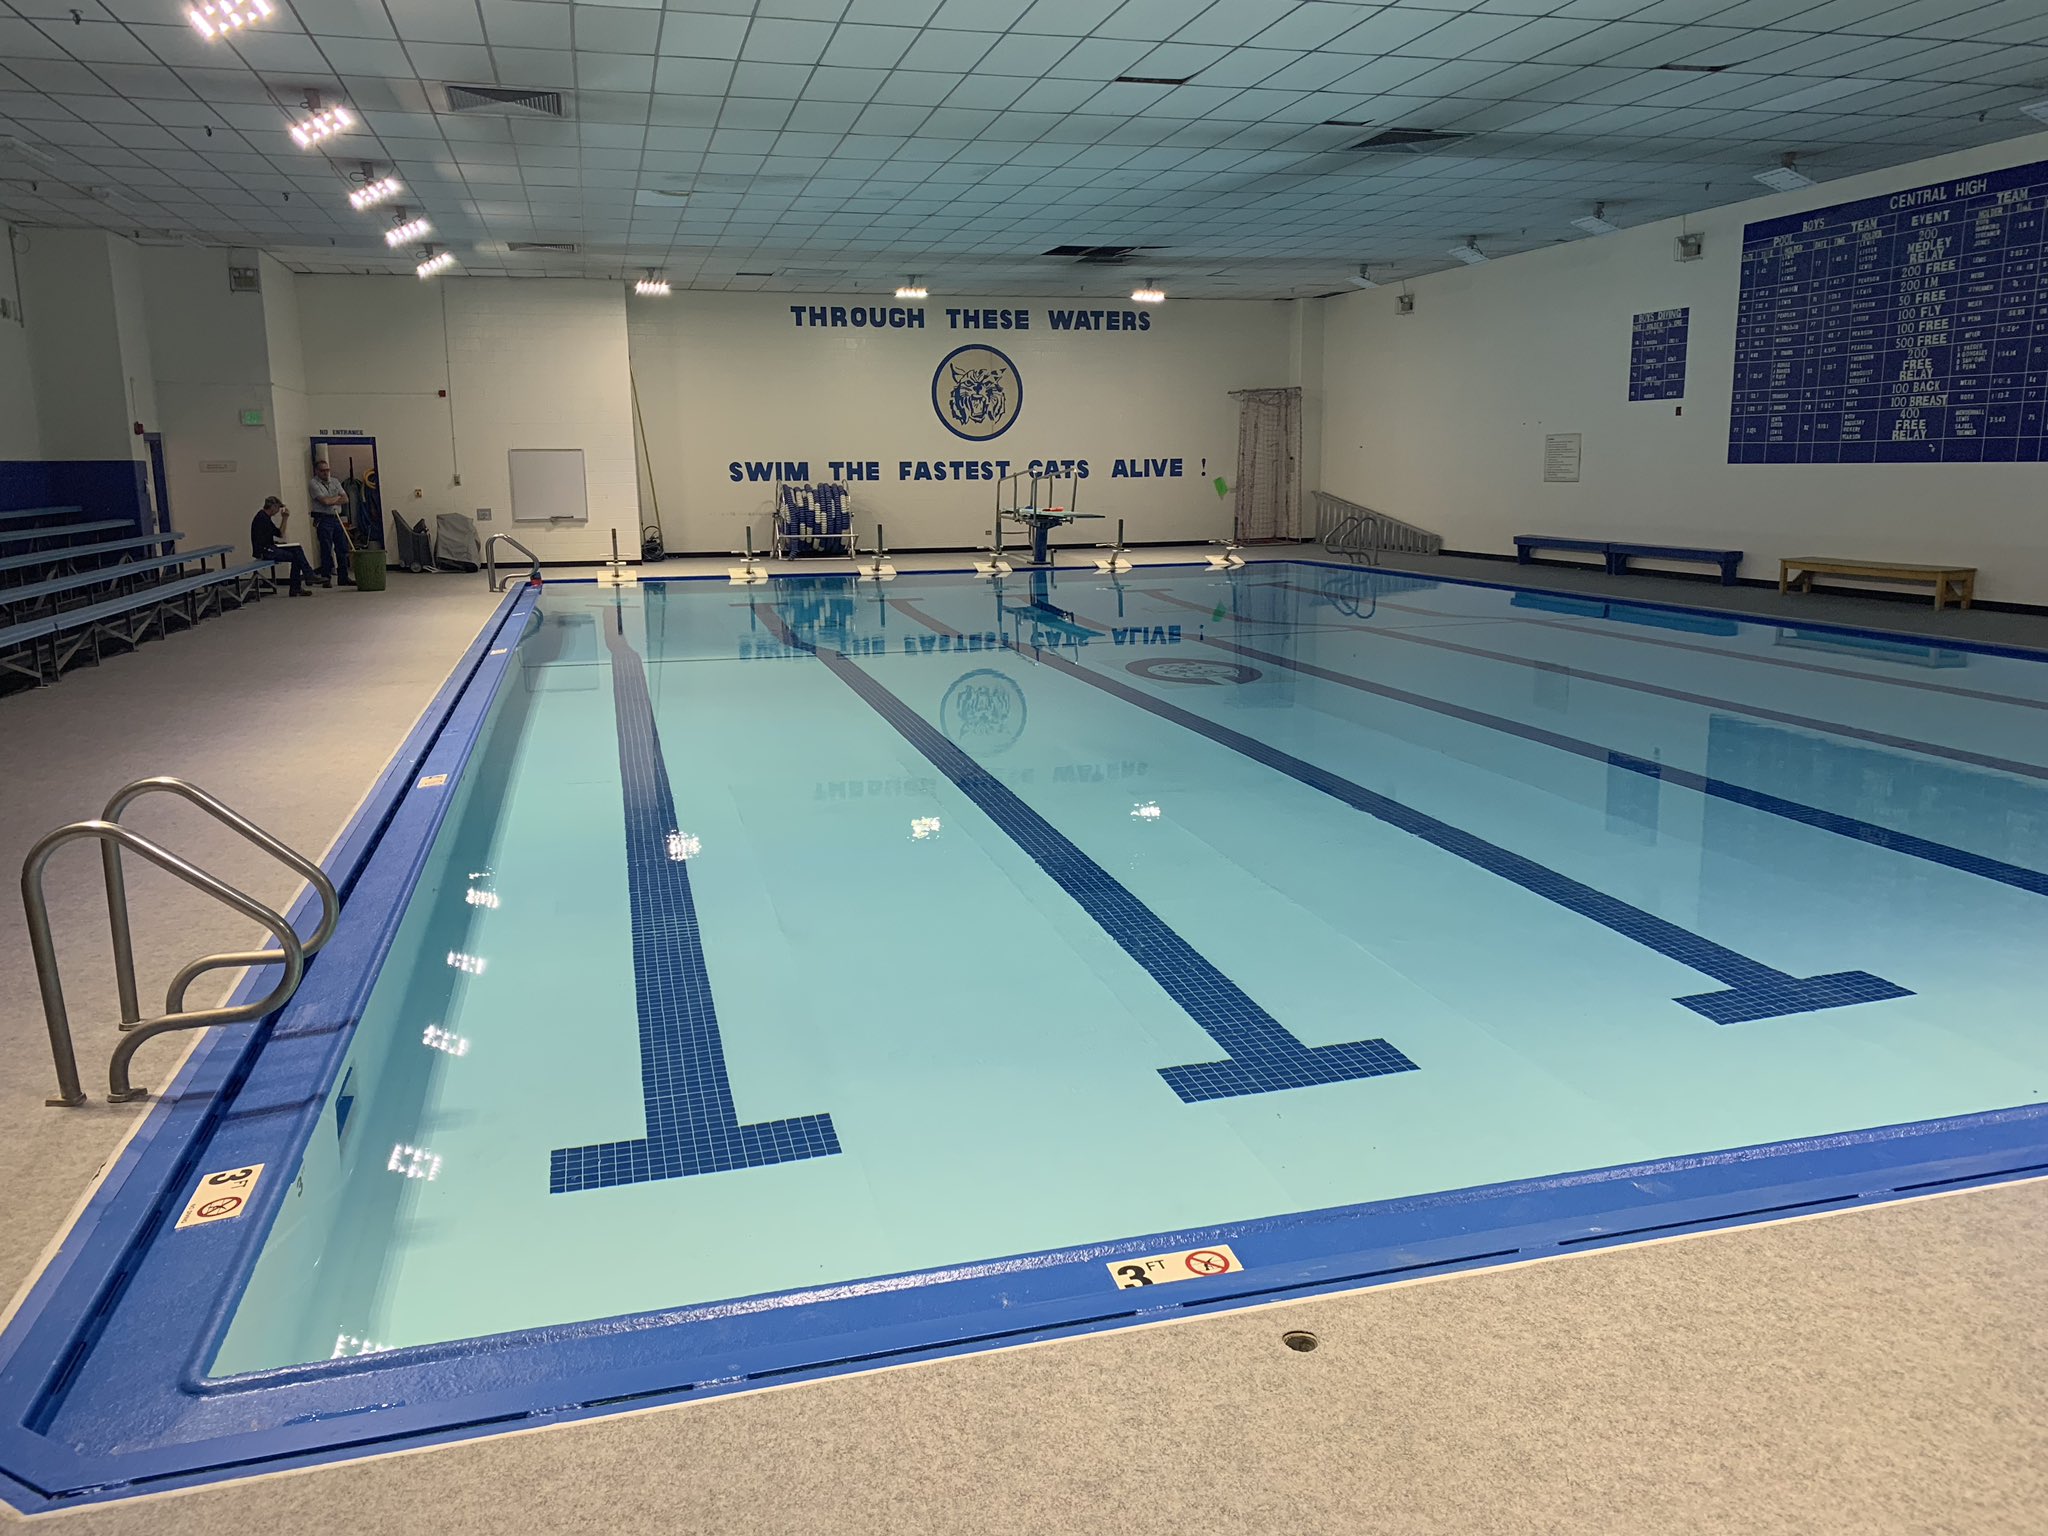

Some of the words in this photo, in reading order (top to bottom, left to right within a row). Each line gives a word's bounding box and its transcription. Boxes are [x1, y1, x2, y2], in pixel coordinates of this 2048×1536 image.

[1890, 187, 1947, 209] CENTRAL
[1956, 179, 1987, 197] HIGH
[1997, 187, 2029, 204] TEAM
[1802, 218, 1825, 232] BOYS
[1851, 218, 1878, 232] TEAM
[1911, 211, 1950, 226] EVENT
[1774, 234, 1795, 246] POOL
[1919, 228, 1938, 241] 200
[1907, 236, 1952, 254] MEDLEY
[1910, 248, 1944, 264] RELAY
[1901, 265, 1921, 278] 200
[1926, 259, 1956, 274] FREE
[1900, 280, 1920, 292] 200
[1925, 277, 1939, 288] IM
[1899, 295, 1910, 306] 50
[1915, 289, 1946, 304] FREE
[790, 305, 926, 329] THROUGH
[945, 308, 1029, 330] THESE
[1048, 310, 1151, 331] WATERS
[1898, 308, 1915, 320] 100
[1920, 304, 1942, 317] FLY
[1897, 323, 1914, 334] 100
[1919, 318, 1949, 332] FREE
[1896, 337, 1913, 348] 500
[1917, 333, 1947, 346] FREE
[1908, 348, 1928, 359] 200
[1903, 358, 1932, 370] FREE
[1900, 368, 1934, 381] RELAY
[1892, 383, 1909, 393] 100
[1913, 380, 1940, 392] BACK
[1891, 397, 1907, 407] 100
[1909, 395, 1948, 406] BREAST
[1900, 408, 1919, 419] 400
[1896, 419, 1926, 430] FREE
[1892, 430, 1927, 440] RELAY
[729, 461, 809, 483] SWIM
[829, 461, 880, 482] THE
[899, 459, 1010, 481] FASTEST
[1028, 459, 1089, 480] CATS
[1111, 458, 1183, 479] ALIVE
[1200, 458, 1208, 476] !
[209, 1168, 253, 1185] 3
[1117, 1265, 1154, 1289] 3
[1146, 1259, 1165, 1271] FT
